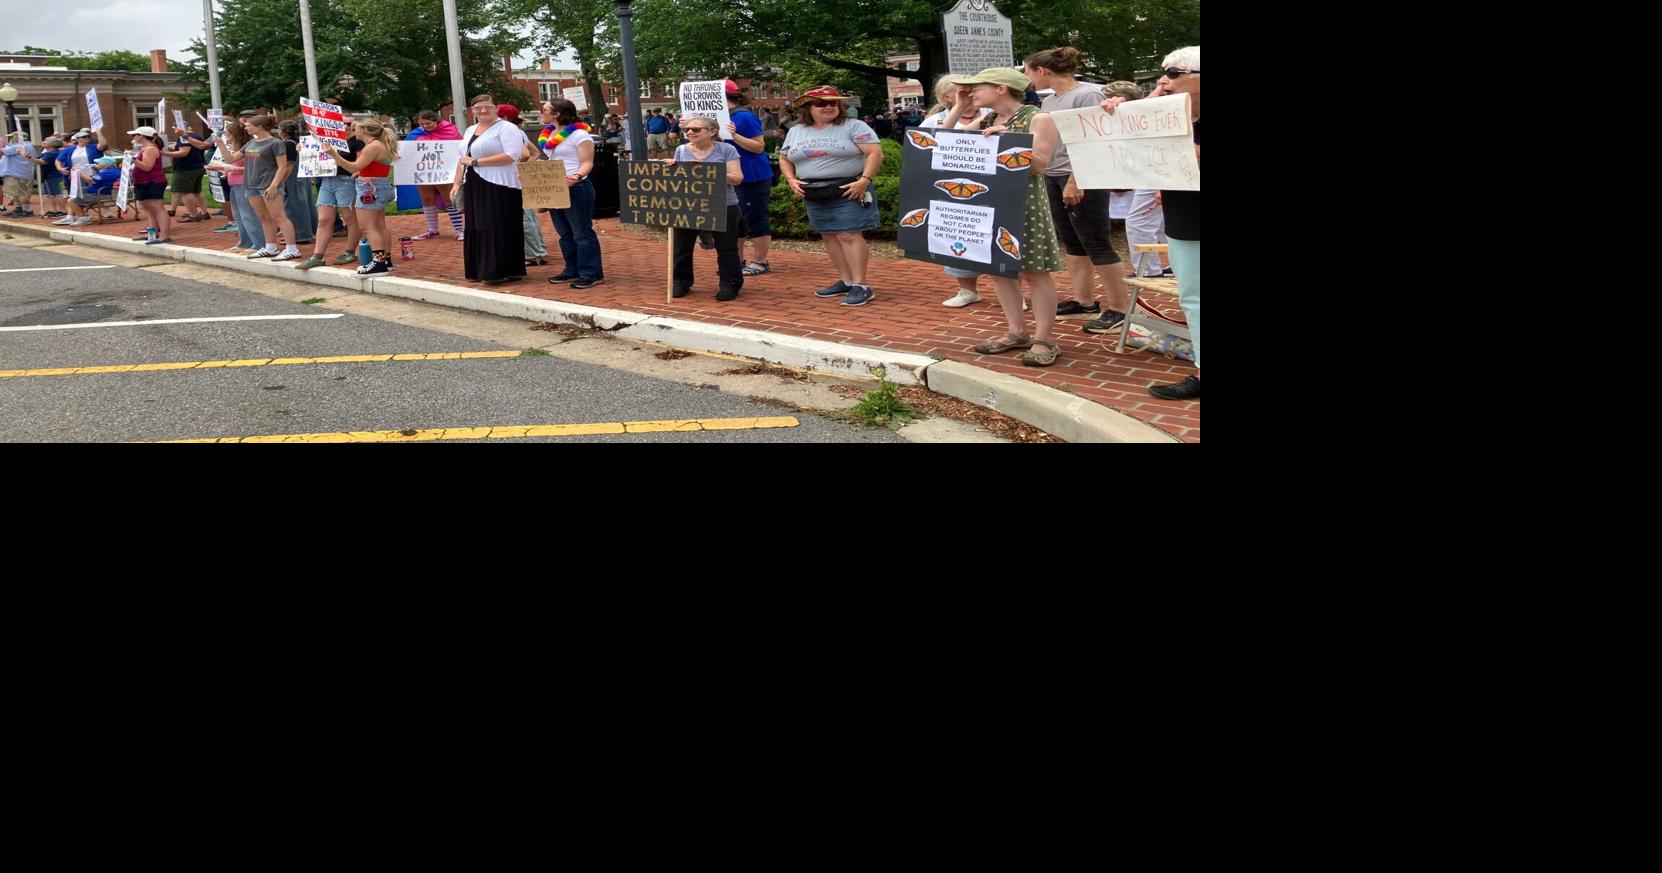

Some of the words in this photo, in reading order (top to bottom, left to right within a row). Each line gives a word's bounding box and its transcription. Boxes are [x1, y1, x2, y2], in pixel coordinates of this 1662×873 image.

[959, 12, 968, 21] THE
[970, 13, 997, 23] COURTHOUSE
[954, 26, 968, 35] QUEEN
[988, 28, 1003, 37] COUNTY
[693, 83, 721, 91] THRONES
[683, 92, 692, 100] NO
[693, 92, 722, 100] CROWNS
[684, 100, 695, 111] NO
[697, 100, 723, 111] KINGS
[1078, 113, 1113, 138] NO
[1120, 115, 1148, 134] KING
[1154, 109, 1181, 132] EVER
[416, 143, 428, 151] He
[940, 146, 991, 154] BUTTERFLIES
[421, 151, 444, 161] NOT
[943, 154, 973, 162] SHOULD
[1108, 144, 1135, 171] NO
[416, 160, 444, 171] OUR
[628, 162, 717, 179] IMPEACH
[942, 162, 985, 171] MONARCHS
[414, 172, 449, 183] KING
[626, 178, 715, 195] CONVICT
[628, 194, 709, 212] REMOVE
[935, 206, 988, 217] AUTHORITARIAN
[940, 213, 969, 222] REGIMES
[935, 225, 958, 233] ABOUT
[958, 229, 985, 238] PEOPLE
[958, 236, 984, 245] PLANET
